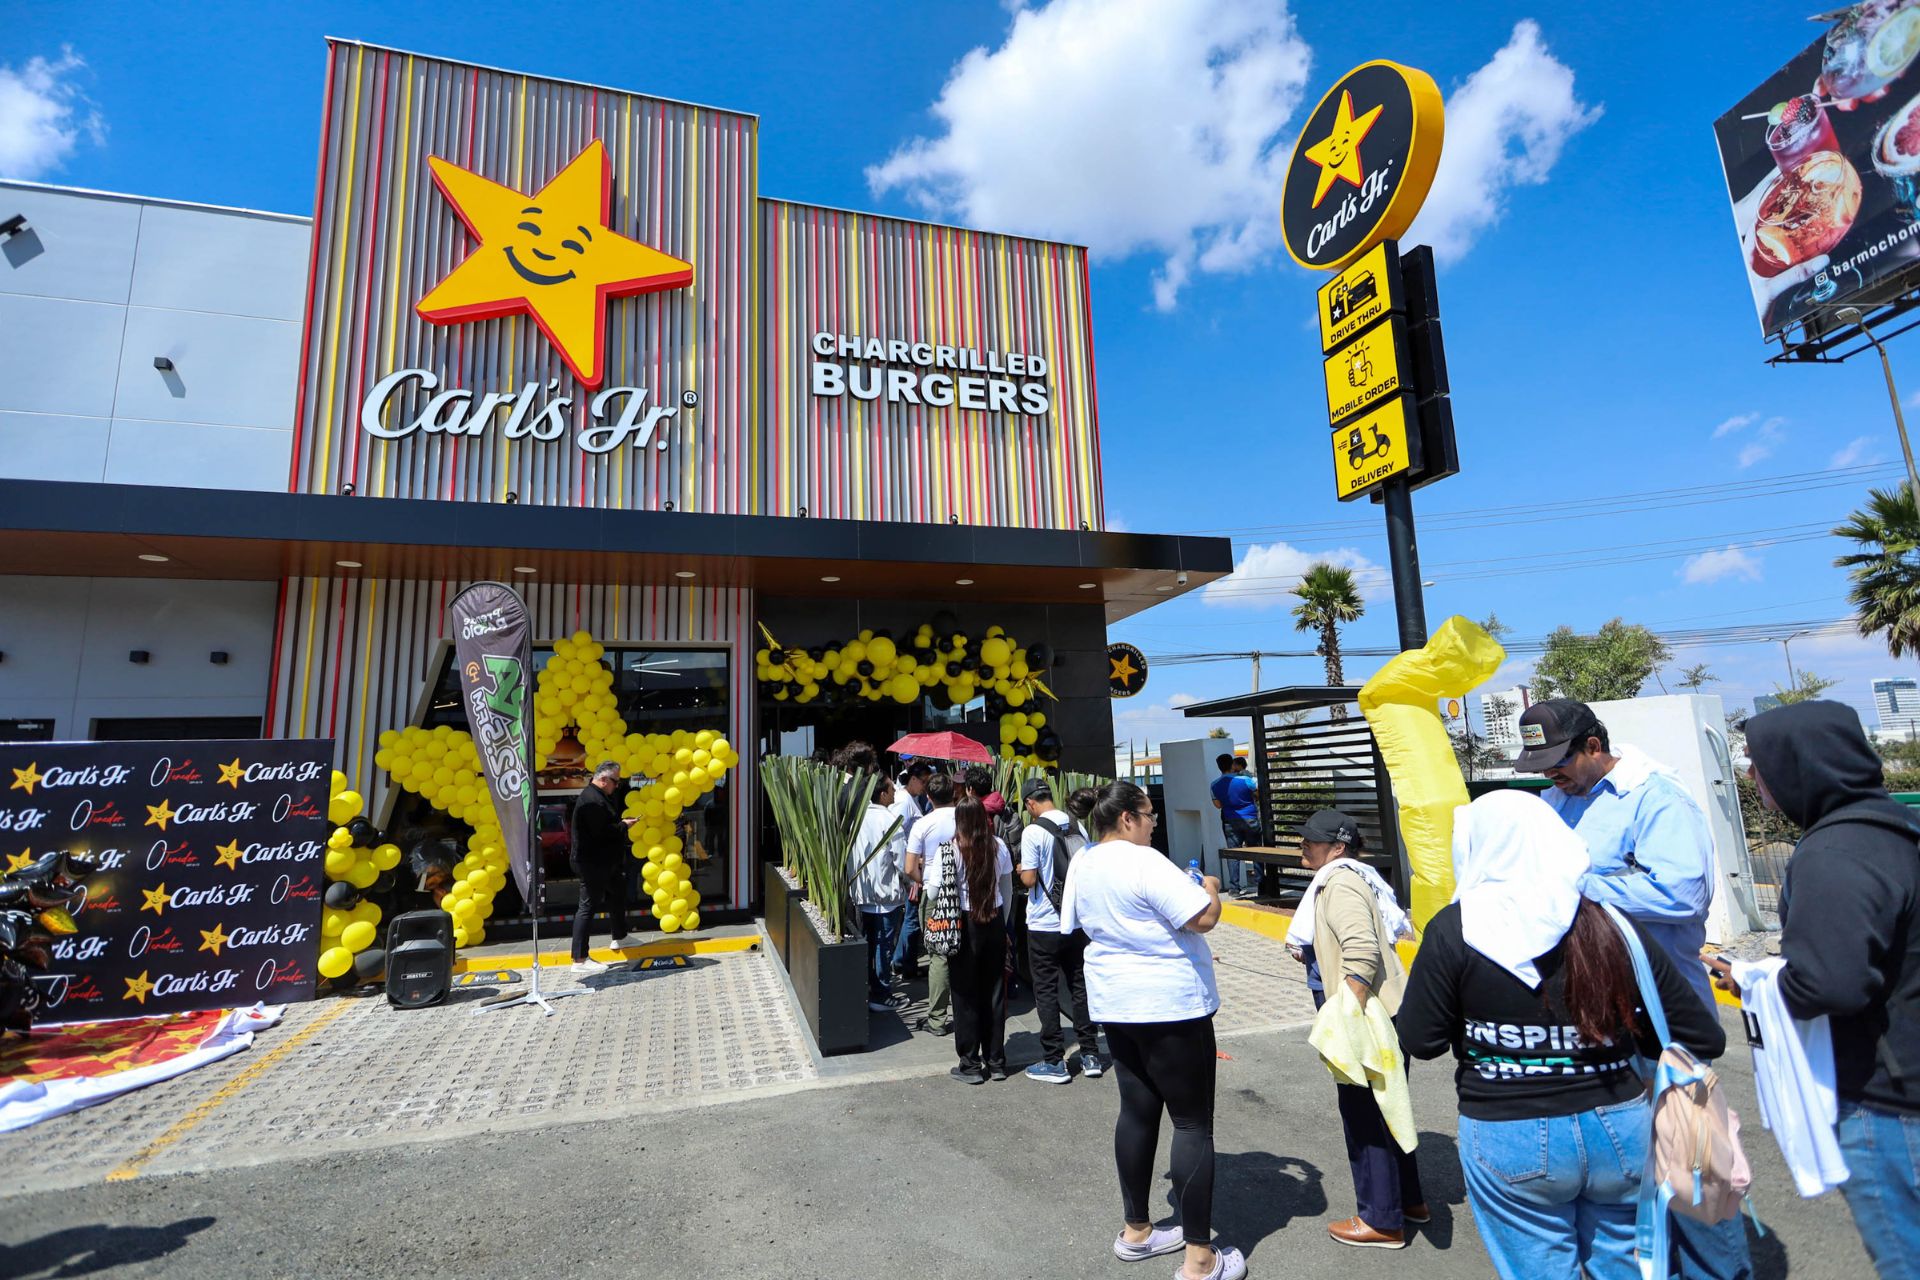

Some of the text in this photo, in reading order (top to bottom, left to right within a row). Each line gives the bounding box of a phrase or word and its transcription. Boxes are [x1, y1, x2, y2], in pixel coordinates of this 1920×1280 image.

[1306, 166, 1390, 259] Carl's Jr.
[1330, 302, 1382, 344] DRIVE THRU
[812, 331, 1048, 377] CHARGRILLED
[812, 361, 1050, 416] BURGERS
[1331, 376, 1397, 421] MOBILE ORDER
[361, 368, 573, 440] Carl's
[1350, 461, 1395, 490] DELIVERY
[41, 765, 130, 789] Carl's Jr.
[244, 761, 323, 783] Carl's Jr.
[13, 808, 46, 832] Jr.
[173, 802, 256, 825] Carl's Jr.
[242, 841, 322, 864] Carl's Jr.
[170, 883, 254, 909] Carl's Jr.
[76, 936, 108, 961] Jr.
[226, 922, 309, 949] Carl's Jr.
[152, 969, 239, 997] Carl's Jr.
